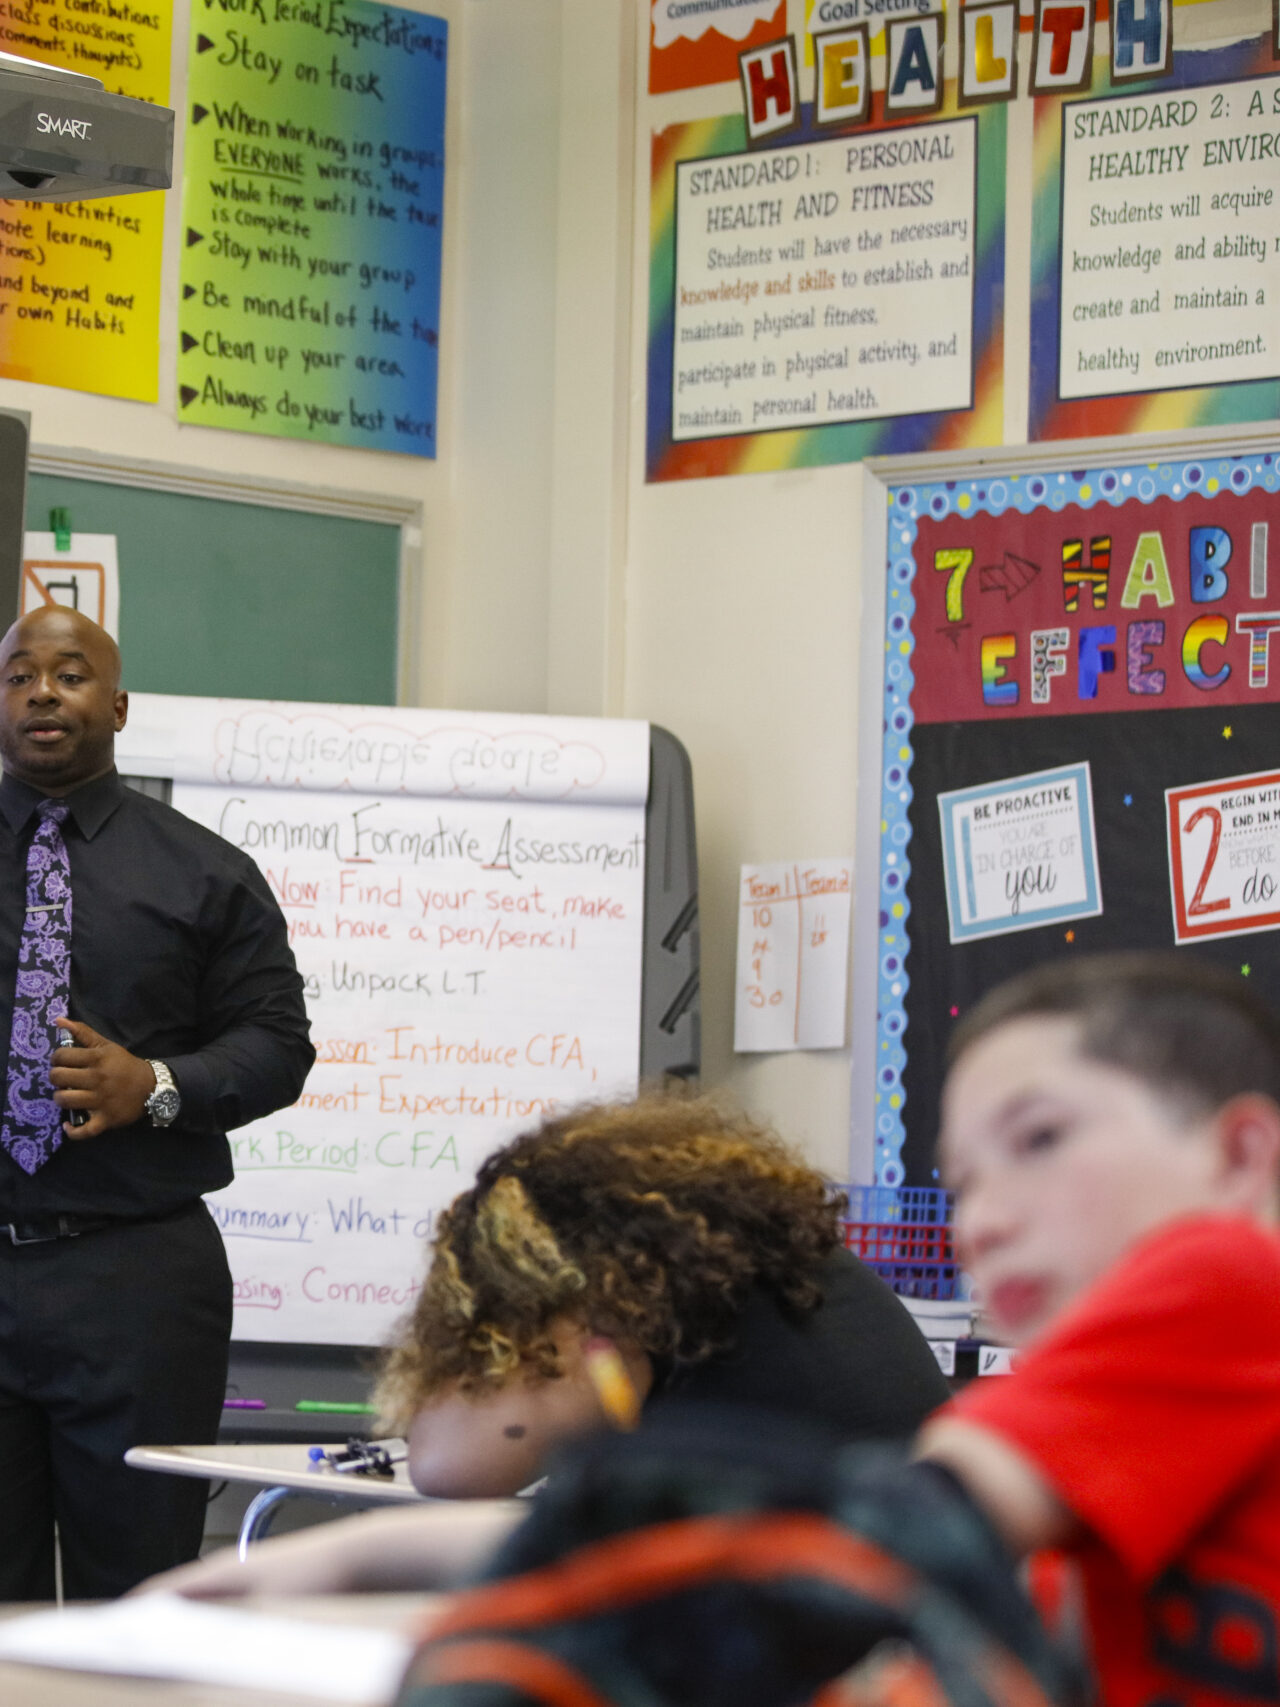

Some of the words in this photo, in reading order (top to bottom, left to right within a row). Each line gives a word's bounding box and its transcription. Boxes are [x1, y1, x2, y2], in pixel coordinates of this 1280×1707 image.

[48, 13, 136, 48] discussions
[217, 30, 282, 84] Stay
[295, 62, 319, 85] on
[326, 56, 383, 102] task
[37, 112, 92, 140] SMART
[213, 101, 270, 138] When
[276, 119, 347, 162] working
[1074, 100, 1198, 139] STANDARD
[1247, 89, 1264, 117] A
[213, 139, 305, 176] EVERYONE
[690, 153, 799, 196] STANDARD
[846, 135, 954, 173] PERSONAL
[1088, 145, 1189, 181] HEALTHY
[706, 200, 782, 233] HEALTH
[794, 192, 839, 221] AND
[851, 180, 934, 211] FITNESS
[1090, 201, 1163, 227] Students
[1170, 195, 1200, 217] will
[1211, 186, 1273, 216] acquire
[46, 220, 113, 262] learning
[208, 230, 251, 269] Stay
[257, 245, 301, 270] with
[308, 256, 352, 279] your
[360, 264, 417, 292] group
[708, 247, 771, 270] Students
[778, 239, 805, 261] will
[814, 236, 851, 258] have
[858, 231, 883, 250] the
[890, 218, 968, 247] necessary
[1072, 245, 1161, 273] knowledge
[1174, 236, 1206, 260] and
[1213, 235, 1267, 263] ability
[31, 275, 90, 304] beyond
[105, 289, 135, 310] and
[681, 278, 758, 306] knowledge
[764, 273, 792, 295] and
[798, 269, 836, 292] skills
[842, 268, 857, 286] to
[863, 260, 934, 286] establish
[940, 255, 970, 278] and
[17, 305, 54, 322] own
[65, 308, 125, 335] Habits
[202, 280, 230, 308] Be
[243, 294, 330, 327] mindful
[335, 305, 356, 328] of
[368, 304, 402, 336] the
[1073, 299, 1123, 321] create
[1130, 290, 1160, 315] and
[1174, 285, 1248, 310] maintain
[1255, 288, 1265, 305] a
[681, 316, 744, 343] maintain
[753, 307, 816, 341] physical
[202, 330, 256, 364] Clean
[264, 347, 289, 371] up
[301, 353, 346, 374] your
[678, 358, 757, 393] participate
[761, 354, 776, 375] in
[785, 346, 849, 381] physical
[928, 333, 958, 357] and
[1077, 347, 1140, 375] healthy
[1155, 333, 1267, 367] environment.
[201, 374, 268, 420] Always
[276, 390, 300, 417] do
[304, 403, 347, 430] your
[349, 397, 385, 431] best
[678, 408, 742, 429] maintain
[753, 392, 817, 422] personal
[934, 547, 974, 622] 7
[1062, 522, 1268, 612] HABI
[980, 612, 1280, 707] EFFECT
[974, 804, 991, 821] BE
[996, 786, 1072, 816] PROACTIVE
[1221, 795, 1255, 811] BEGIN
[1232, 815, 1254, 828] END
[1258, 811, 1270, 823] IN
[220, 797, 344, 862] Common
[351, 803, 483, 866] Formative
[488, 817, 645, 879] Assessment
[975, 853, 995, 874] IN
[1000, 839, 1054, 869] CHARGE
[1059, 834, 1077, 856] OF
[1183, 806, 1231, 917] 2
[339, 869, 402, 908] Find
[417, 889, 473, 926] your
[486, 887, 558, 918] seat,
[563, 895, 627, 920] make
[1005, 863, 1057, 916] you
[1243, 867, 1278, 905] do
[287, 920, 325, 946] you
[336, 909, 389, 940] have
[410, 925, 429, 942] a
[438, 918, 578, 951] pen/pencil
[753, 906, 772, 928] 10
[331, 961, 430, 998] Unpack
[385, 1026, 516, 1067] Introduce
[378, 1075, 557, 1119] Expectations
[375, 1131, 460, 1171] CFA
[327, 1197, 407, 1235] What
